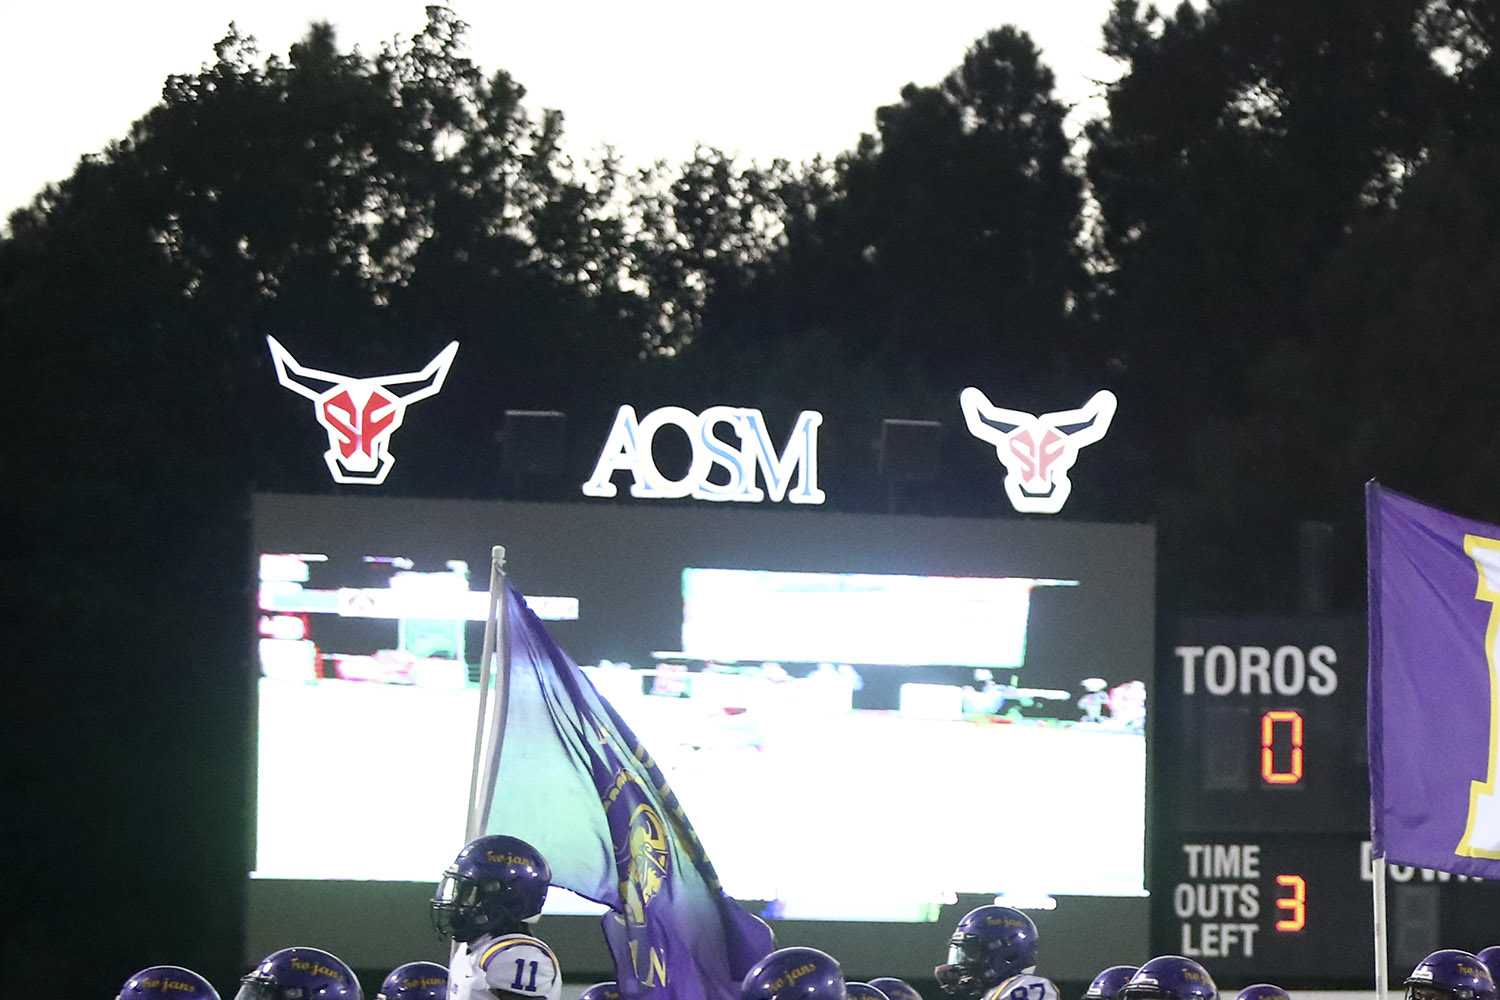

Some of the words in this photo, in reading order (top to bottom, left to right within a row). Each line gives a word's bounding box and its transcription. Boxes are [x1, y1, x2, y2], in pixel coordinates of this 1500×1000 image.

[582, 404, 826, 504] AOSM
[1175, 645, 1338, 696] TOROS
[1261, 710, 1303, 784] 0
[1183, 844, 1260, 879] TIME
[1174, 883, 1260, 918] OUTS
[1275, 875, 1306, 932] 3
[1181, 923, 1259, 958] LEFT
[511, 958, 539, 992] 11
